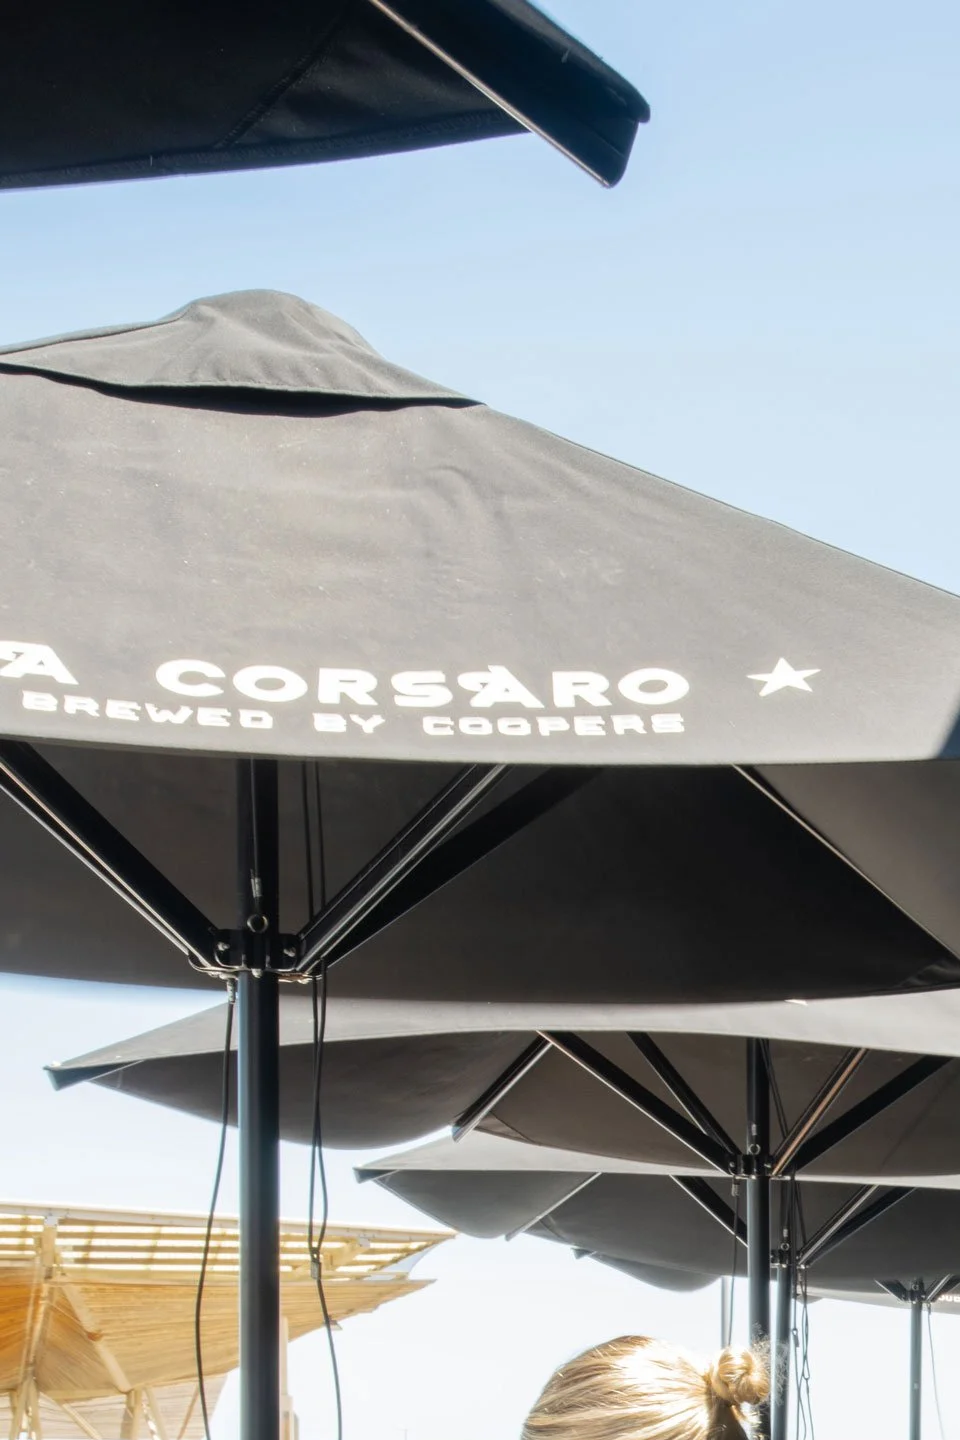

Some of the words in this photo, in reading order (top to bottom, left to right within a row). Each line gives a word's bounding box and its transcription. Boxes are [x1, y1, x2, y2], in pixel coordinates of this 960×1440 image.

[155, 659, 690, 709] CORSARO
[22, 690, 273, 729] BREWED
[312, 713, 385, 734] BY
[422, 713, 685, 736] COOPERS
